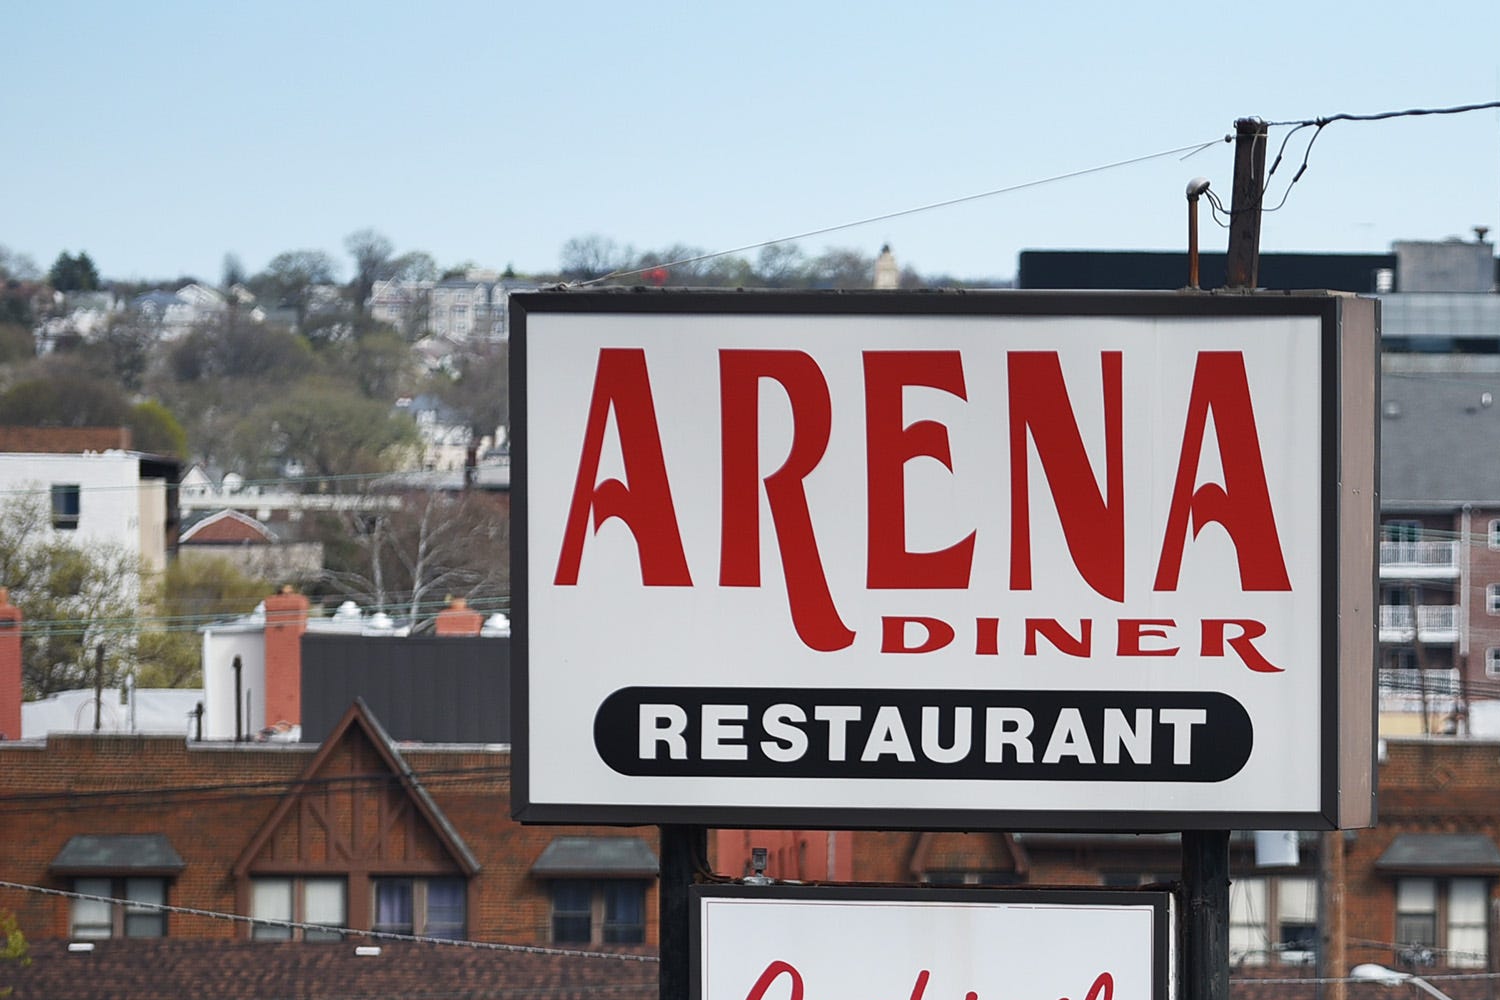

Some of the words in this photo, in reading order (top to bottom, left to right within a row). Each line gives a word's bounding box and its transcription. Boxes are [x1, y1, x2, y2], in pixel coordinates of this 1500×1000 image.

[554, 347, 1293, 653] ARENA
[880, 615, 1286, 674] DINER
[638, 703, 1207, 766] RESTAURANT
